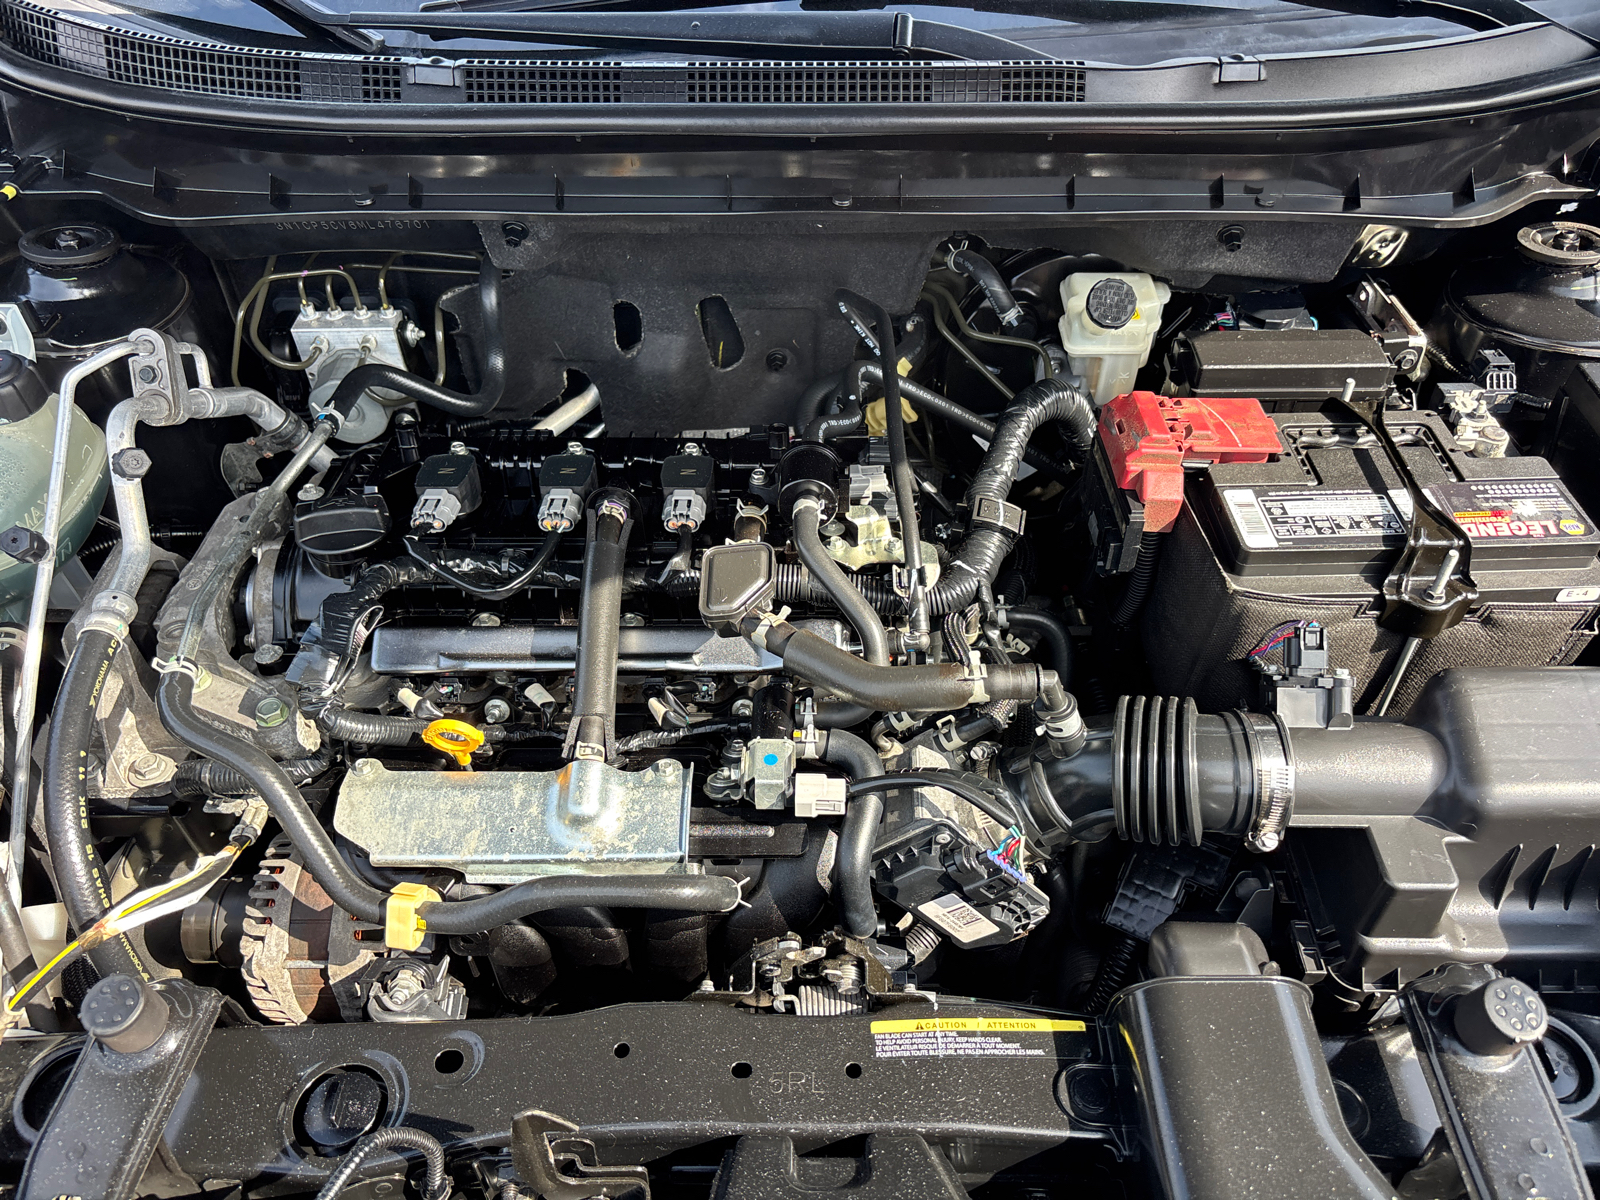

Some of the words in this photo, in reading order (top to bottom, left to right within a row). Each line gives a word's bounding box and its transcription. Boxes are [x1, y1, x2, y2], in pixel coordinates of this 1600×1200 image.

[274, 219, 430, 230] 3N1CP5CV6ML476701
[1455, 515, 1512, 525] Premium
[1461, 520, 1560, 538] LEGEND
[1562, 523, 1582, 531] NAPA
[92, 659, 110, 697] YOKOHAMA
[78, 795, 89, 829] 20K
[924, 1021, 967, 1029] CAUTION
[986, 1021, 1037, 1029] ATTENTION
[983, 1048, 1017, 1056] APPROCHER
[1025, 1048, 1046, 1056] MAINS.
[768, 1070, 826, 1095] 5RL
